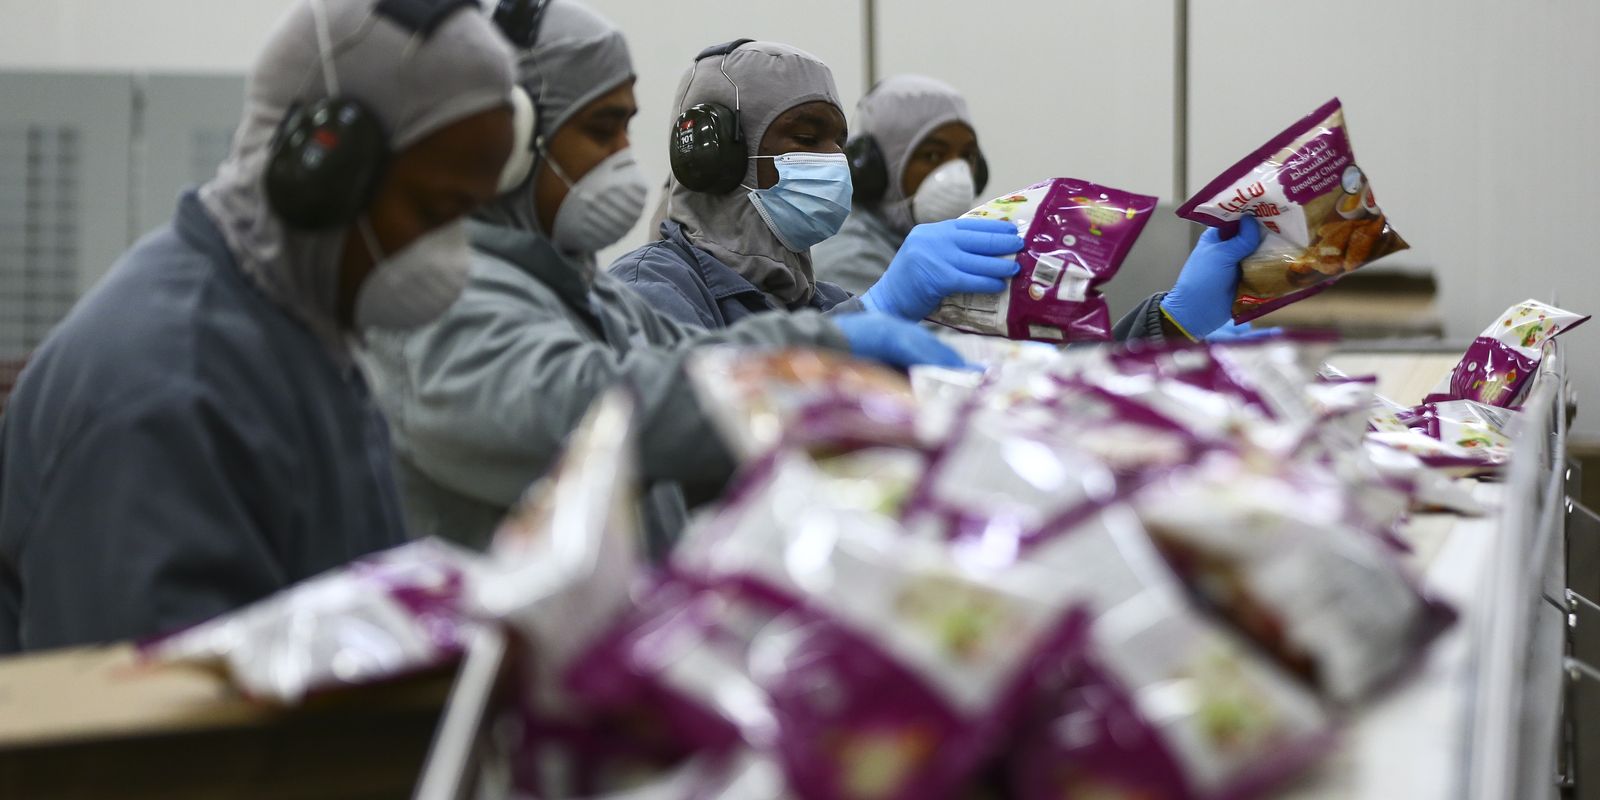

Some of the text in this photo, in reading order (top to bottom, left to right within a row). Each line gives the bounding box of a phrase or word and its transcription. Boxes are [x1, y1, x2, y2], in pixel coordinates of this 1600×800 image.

[680, 133, 694, 145] 101
[1290, 171, 1320, 194] Breaded
[1320, 155, 1347, 176] Chicken
[1311, 173, 1338, 192] Tenders
[1252, 201, 1281, 218] adia
